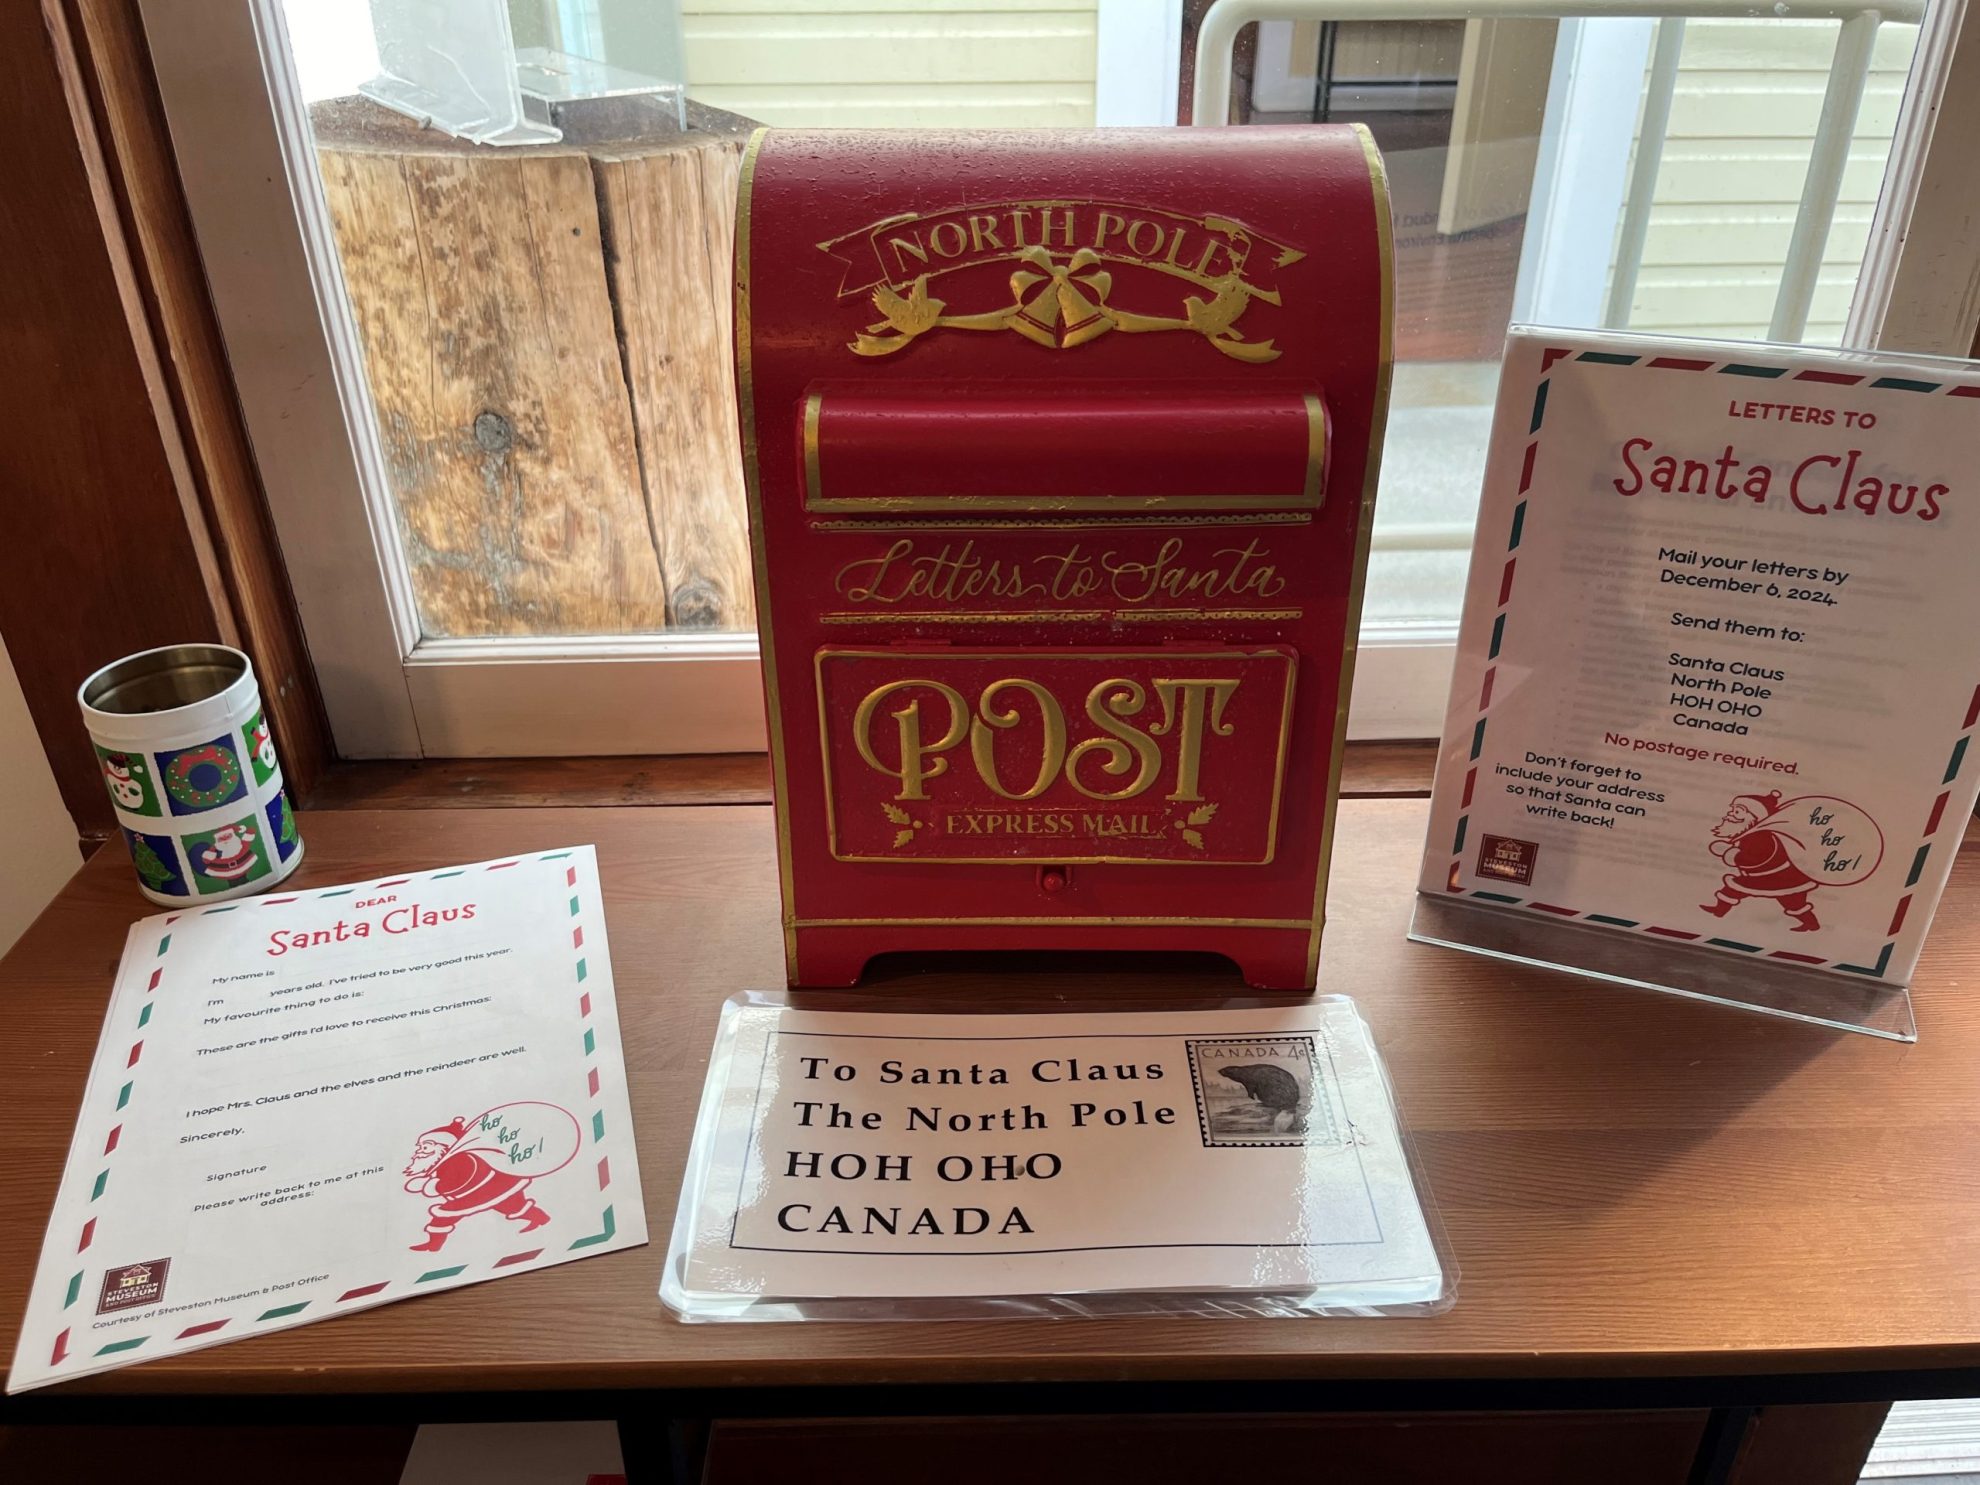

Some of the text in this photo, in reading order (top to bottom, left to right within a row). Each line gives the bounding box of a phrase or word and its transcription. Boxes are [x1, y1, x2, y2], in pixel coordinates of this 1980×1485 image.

[889, 211, 1233, 278] NORTH POLE
[1729, 401, 1876, 429] LETTERS TO
[1613, 438, 1949, 521] Santa Claus
[835, 537, 1285, 602] Letters to Santa
[1658, 548, 1849, 586] Mail your letters by
[1660, 569, 1762, 595] December
[1766, 584, 1781, 598] 6,
[1671, 613, 1805, 642] Send them to:
[1668, 653, 1785, 681] Santa Claus
[1670, 671, 1772, 699] North Pole
[1673, 713, 1749, 737] Canada
[853, 679, 1241, 801] POST
[1604, 732, 1799, 775] No postage required.
[1525, 752, 1642, 781] Don't forget to
[1495, 762, 1665, 802] include your address
[1506, 784, 1645, 816] so that Santa can
[946, 813, 1157, 838] EXPRESS MAIL
[1526, 804, 1614, 828] write back!
[1810, 808, 1834, 825] ho
[1821, 828, 1845, 846] ho
[1823, 853, 1860, 872] ho!
[355, 896, 397, 909] DEAR
[267, 904, 477, 956] Santa Claus
[208, 948, 513, 1007] I'm years old. I've tried to be very good this year.
[212, 976, 229, 984] My
[231, 972, 264, 981] name
[204, 1017, 222, 1025] My
[224, 1005, 281, 1020] favourite
[284, 999, 316, 1012] thing
[351, 990, 364, 998] is:
[197, 1044, 233, 1056] These
[236, 1040, 256, 1049] are
[259, 1035, 279, 1045] the
[281, 1029, 308, 1041] gifts
[310, 1026, 323, 1034] I'd
[325, 1022, 349, 1031] love
[366, 1013, 407, 1025] receive
[409, 1008, 431, 1017] this
[433, 996, 492, 1013] Christmas:
[1202, 1047, 1279, 1059] CANADA
[192, 1106, 225, 1118] hope
[227, 1101, 253, 1109] Mrs.
[256, 1094, 291, 1105] Claus
[293, 1088, 318, 1098] and
[321, 1084, 341, 1092] the
[343, 1078, 375, 1089] elves
[378, 1072, 401, 1082] and
[404, 1067, 423, 1077] the
[426, 1058, 476, 1073] reindeer
[479, 1054, 499, 1062] are
[500, 1046, 526, 1056] well.
[800, 1058, 1164, 1085] To Santa Claus
[480, 1115, 503, 1131] ho
[793, 1101, 1176, 1132] The North Pole
[180, 1127, 245, 1144] Sincerely,
[498, 1128, 521, 1144] ho
[508, 1137, 544, 1164] ho!
[206, 1165, 267, 1182] Signature
[194, 1198, 236, 1212] Please
[239, 1190, 272, 1203] write
[275, 1184, 305, 1195] back
[324, 1177, 343, 1185] me
[346, 1172, 360, 1180] at
[362, 1166, 384, 1176] this
[260, 1191, 315, 1207] address:
[777, 1204, 1035, 1235] CANADA
[93, 1313, 141, 1329] Courtesy
[158, 1301, 211, 1316] Steveston
[214, 1290, 259, 1304] Museum
[271, 1281, 295, 1291] Post
[298, 1274, 329, 1287] Office
[106, 1287, 157, 1302] MUSEUM
[108, 1283, 158, 1295] STEVESTON
